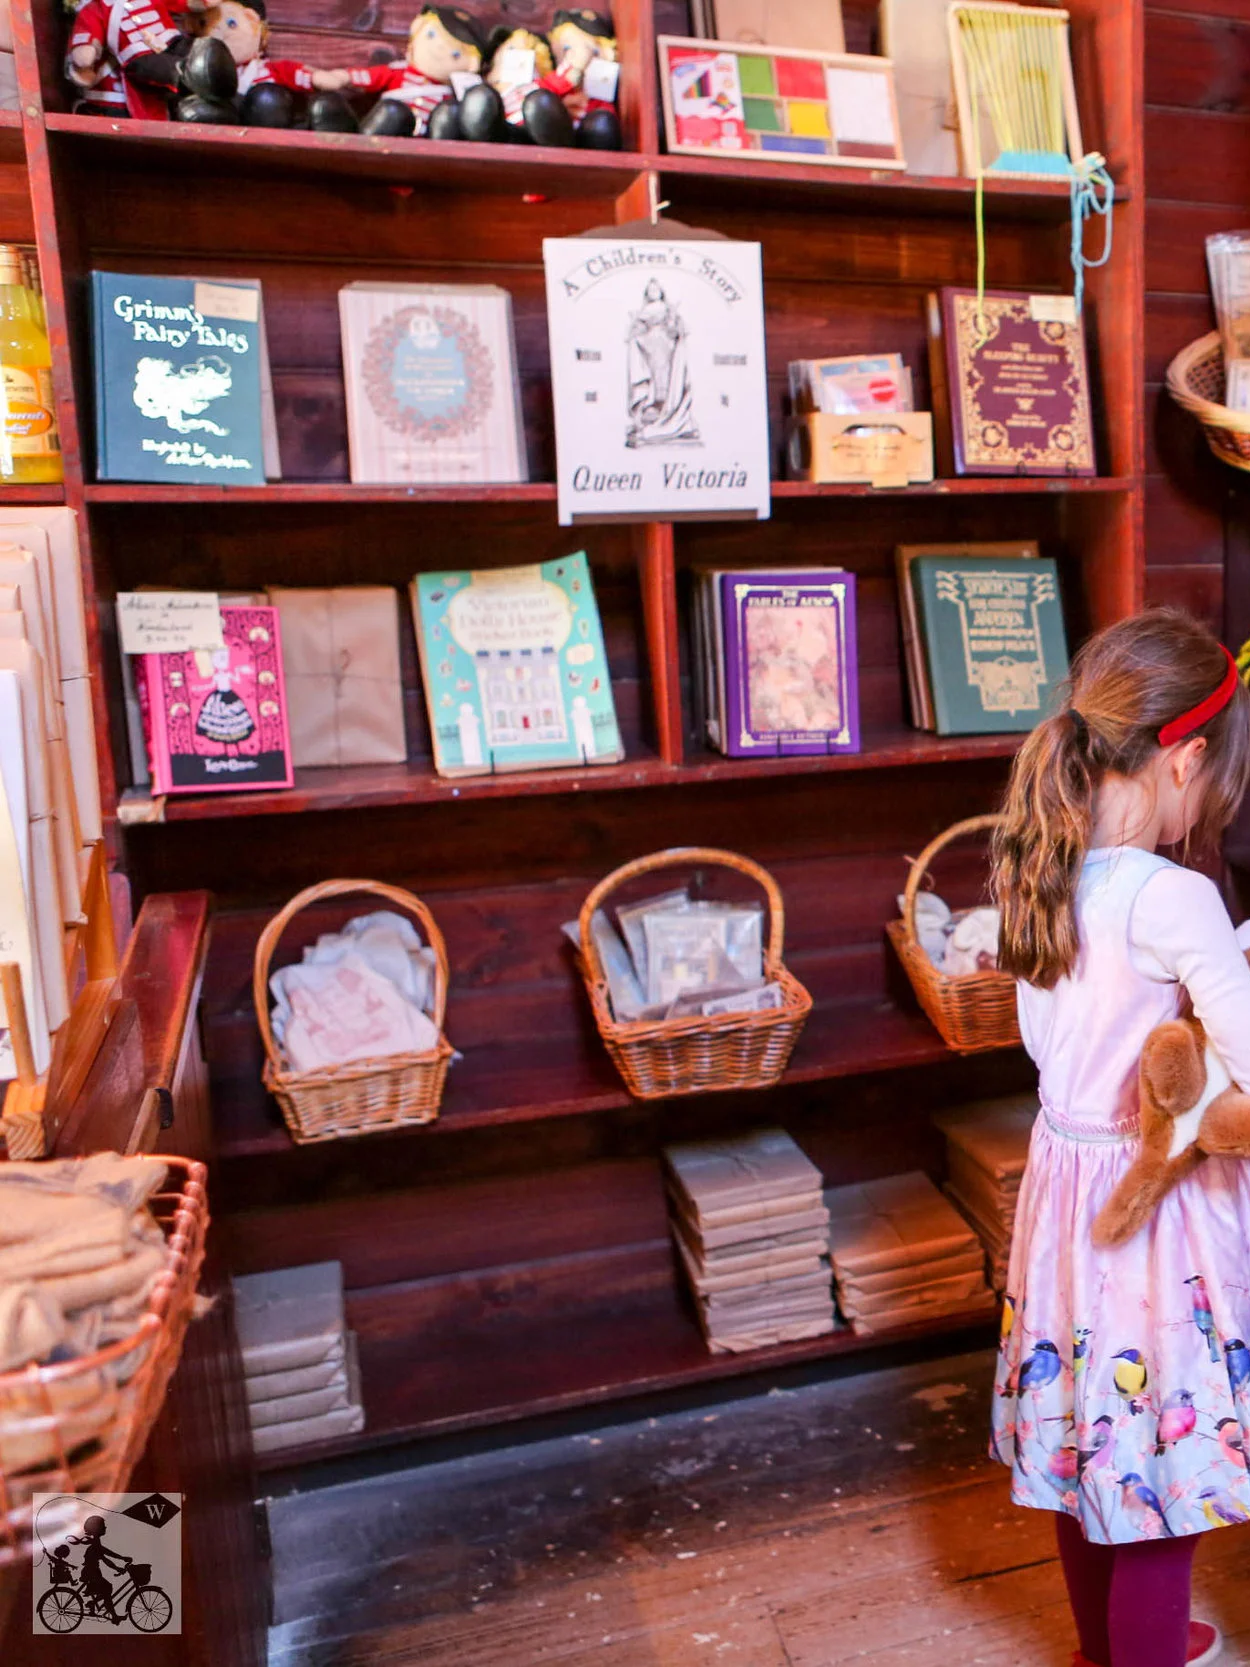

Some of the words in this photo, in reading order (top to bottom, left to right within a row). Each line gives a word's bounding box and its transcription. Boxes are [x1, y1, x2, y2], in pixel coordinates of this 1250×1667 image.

[562, 278, 580, 297] A
[586, 247, 682, 277] Children's
[700, 258, 742, 304] Story
[191, 322, 249, 354] Tales
[573, 465, 643, 492] Queen
[663, 462, 748, 490] Victoria
